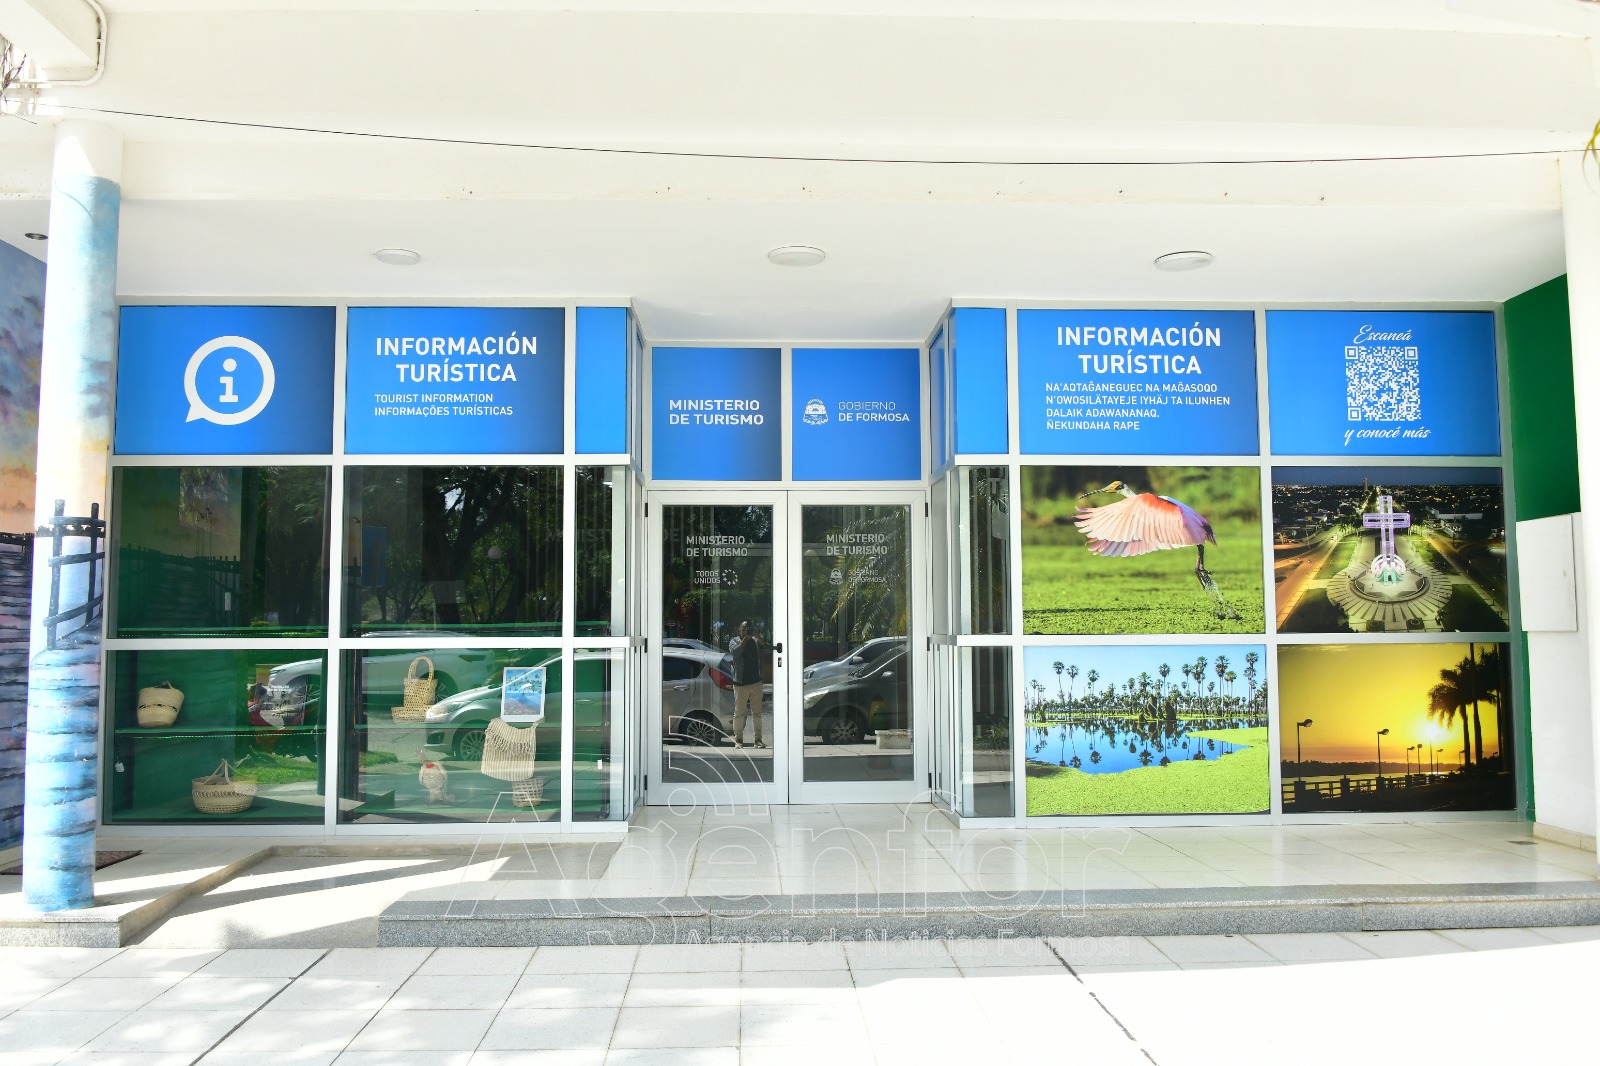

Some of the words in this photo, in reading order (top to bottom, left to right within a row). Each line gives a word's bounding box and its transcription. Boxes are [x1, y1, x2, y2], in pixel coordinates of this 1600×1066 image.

[1057, 321, 1221, 347] INFORMACIÓN
[1353, 324, 1412, 345] Escaneá
[376, 331, 537, 356] INFORMACIÓN
[1078, 349, 1202, 375] TURÍSTICA
[396, 358, 517, 383] TURÍSTICA
[1145, 383, 1160, 392] NA
[375, 393, 419, 403] TOURIST
[421, 393, 493, 403] INFORMATION
[1140, 394, 1168, 405] IYHÄJ
[1170, 396, 1183, 405] TA
[1185, 396, 1230, 405] ILUNHEN
[374, 405, 450, 417] INFORMAÇÕES
[452, 404, 513, 416] TURÍSTICAS
[669, 399, 760, 411] MINISTERIO
[838, 401, 896, 411] GOBIERNO
[838, 412, 854, 422] DE
[856, 412, 910, 422] FORMOSA
[1046, 408, 1083, 418] DALAIK
[1085, 408, 1160, 418] ADAWANANAQ.
[669, 414, 690, 425] DE
[693, 413, 764, 425] TURISMO
[1046, 419, 1111, 430] ÑEKUNDAHA
[1113, 421, 1140, 430] RAPE
[1344, 428, 1356, 447] y
[1356, 426, 1401, 439] conocé
[1402, 426, 1431, 439] más
[686, 535, 746, 545] MINISTERIO
[826, 533, 885, 544] MINISTERIO
[686, 547, 700, 557] DE
[702, 547, 748, 557] TURISMO
[826, 545, 840, 556] DE
[841, 545, 888, 555] TURISMO
[695, 570, 719, 578] TODOS
[694, 577, 721, 585] UNIDOS
